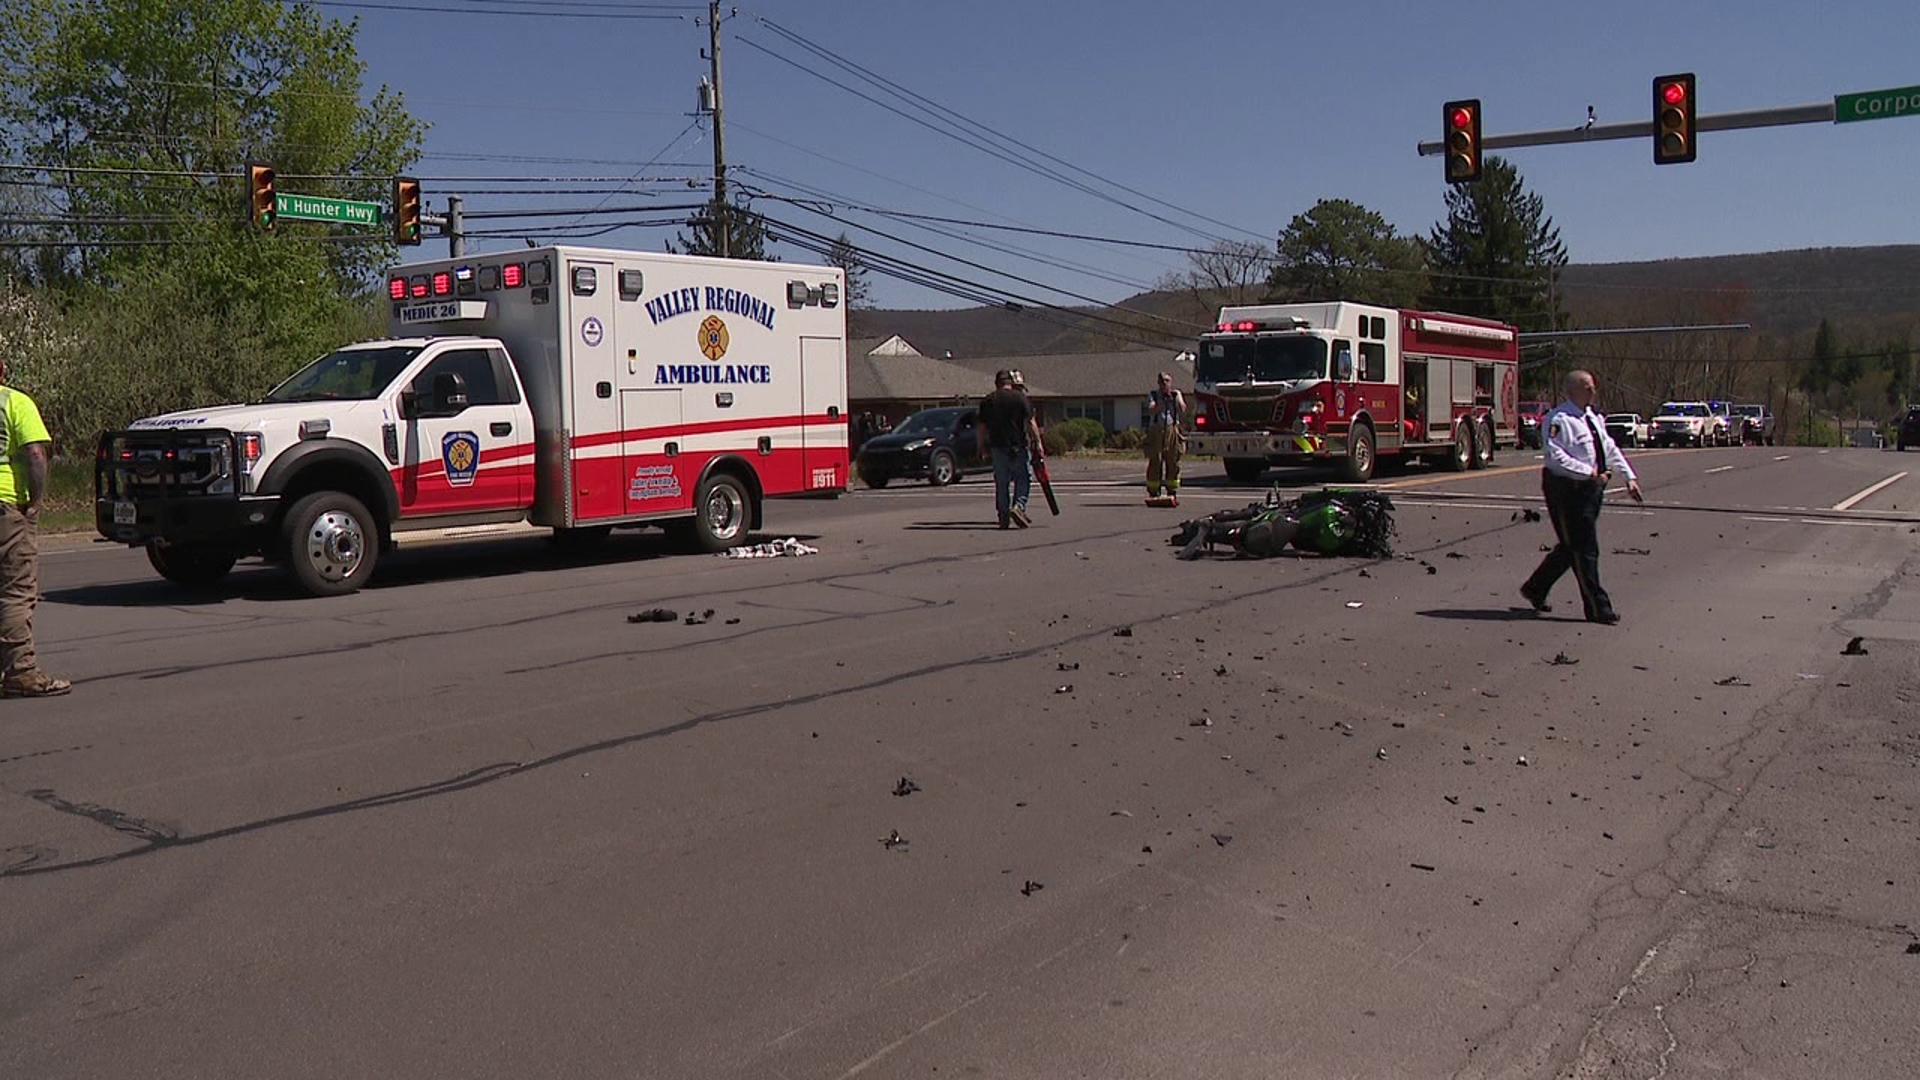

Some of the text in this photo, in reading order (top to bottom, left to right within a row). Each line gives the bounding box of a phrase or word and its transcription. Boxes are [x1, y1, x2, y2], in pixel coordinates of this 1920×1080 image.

[1855, 94, 1920, 114] Corpo
[278, 198, 373, 222] N Hunter Hwy
[402, 304, 457, 321] MEDIC 26
[644, 286, 775, 331] VALLEY REGIONAL
[654, 364, 771, 384] AMBULANCE
[818, 473, 835, 488] 911
